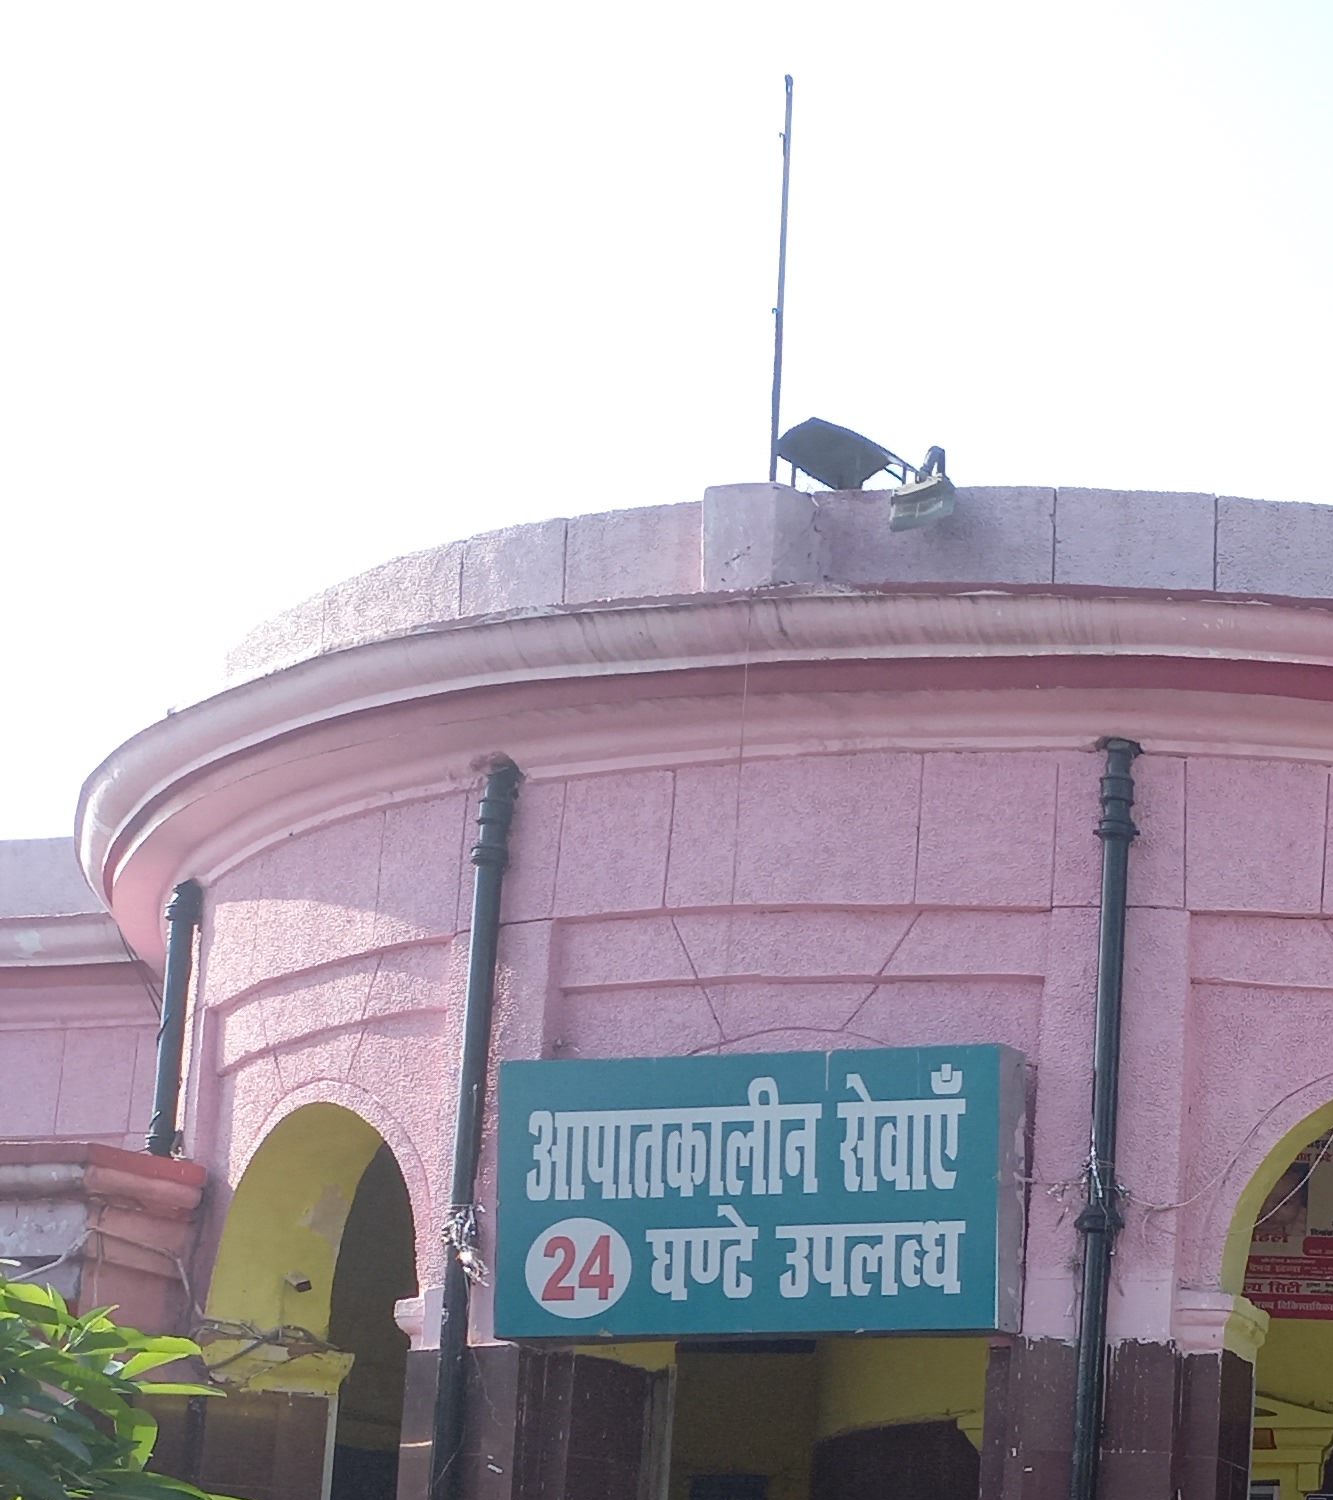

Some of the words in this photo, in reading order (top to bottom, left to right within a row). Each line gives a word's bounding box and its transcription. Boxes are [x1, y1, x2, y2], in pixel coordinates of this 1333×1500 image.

[527, 1077, 822, 1201] आपातकालीन
[837, 1064, 966, 1191] सेवाएँ
[541, 1235, 614, 1301] 24
[646, 1205, 758, 1300] घण्टे
[776, 1219, 966, 1299] उपलब्ध
